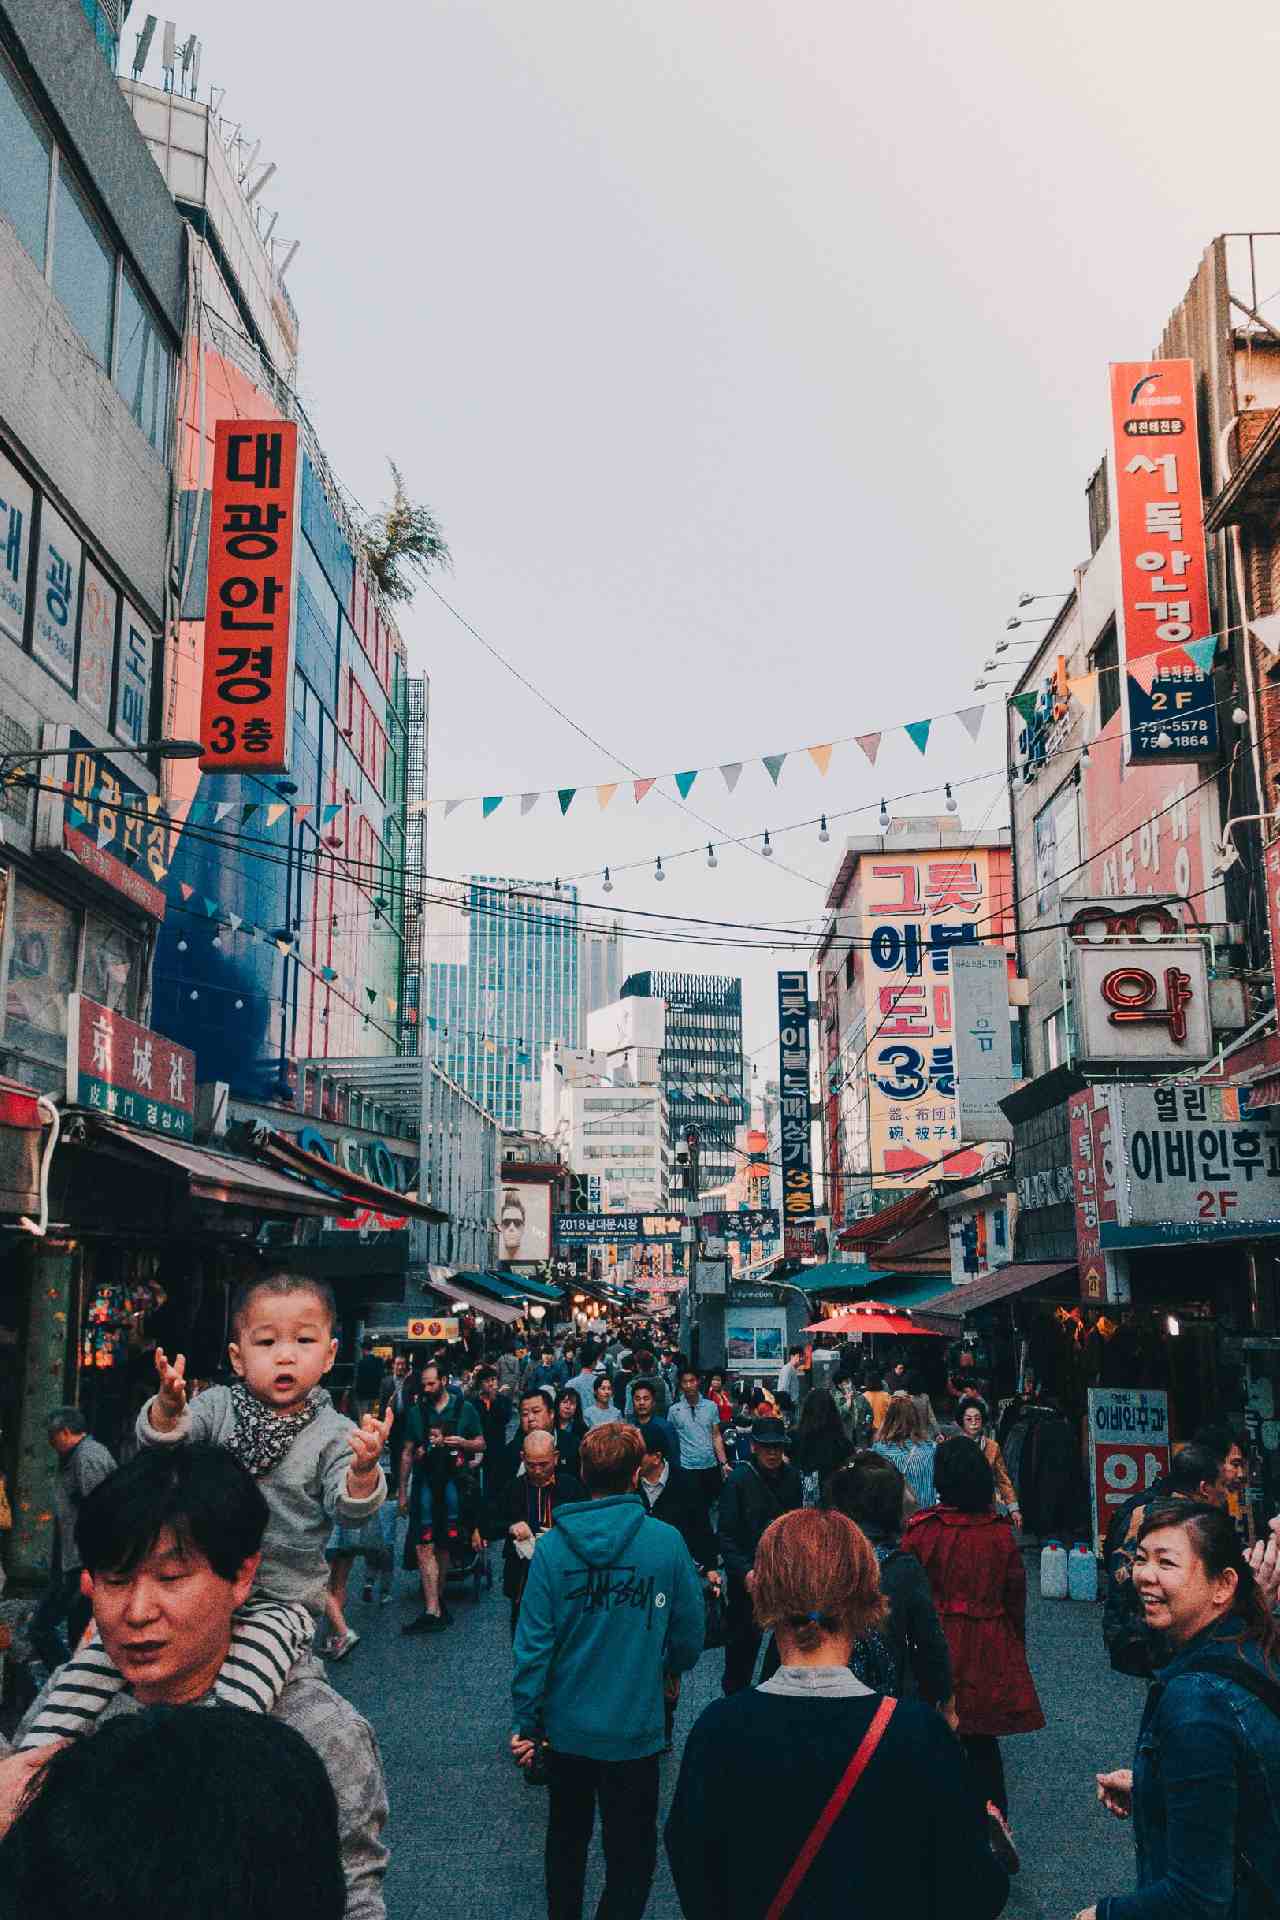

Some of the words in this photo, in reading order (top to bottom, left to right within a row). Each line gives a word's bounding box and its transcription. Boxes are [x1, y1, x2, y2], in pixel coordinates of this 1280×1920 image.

[215, 432, 287, 705] 대광안경
[1124, 454, 1193, 642] 서독안경
[210, 715, 273, 754] 3층
[1141, 735, 1209, 748] 75-1864
[869, 863, 982, 916] 그릇
[1102, 967, 1193, 1041] 약
[1154, 1087, 1207, 1122] 열린
[1197, 1191, 1239, 1218] 2F
